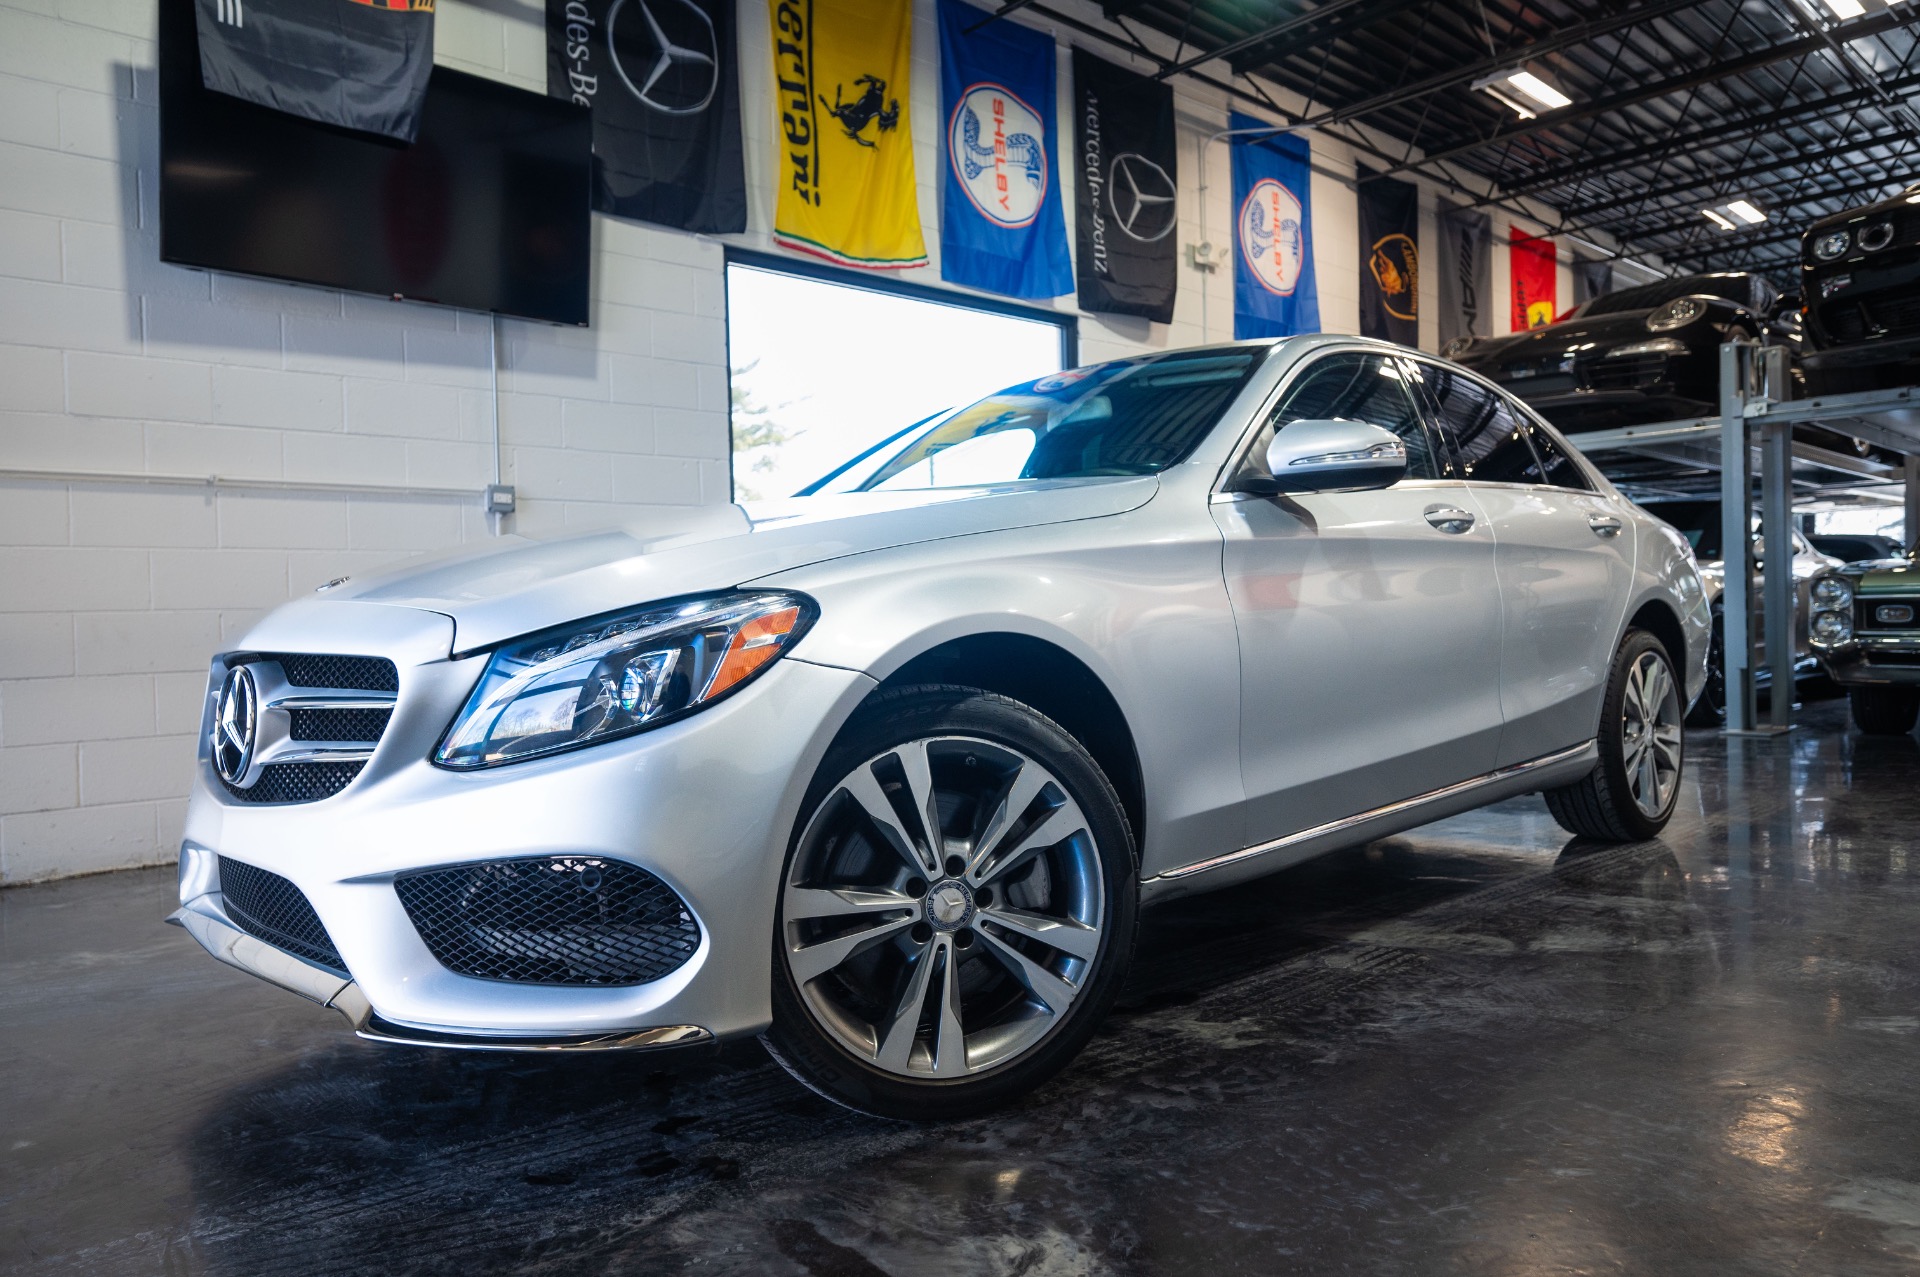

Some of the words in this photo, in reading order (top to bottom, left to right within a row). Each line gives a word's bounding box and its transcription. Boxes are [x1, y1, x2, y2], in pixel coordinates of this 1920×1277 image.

[565, 0, 598, 108] des-Be
[777, 0, 821, 208] errari
[992, 97, 1010, 212] SHELBY
[1271, 190, 1285, 283] SHELBY
